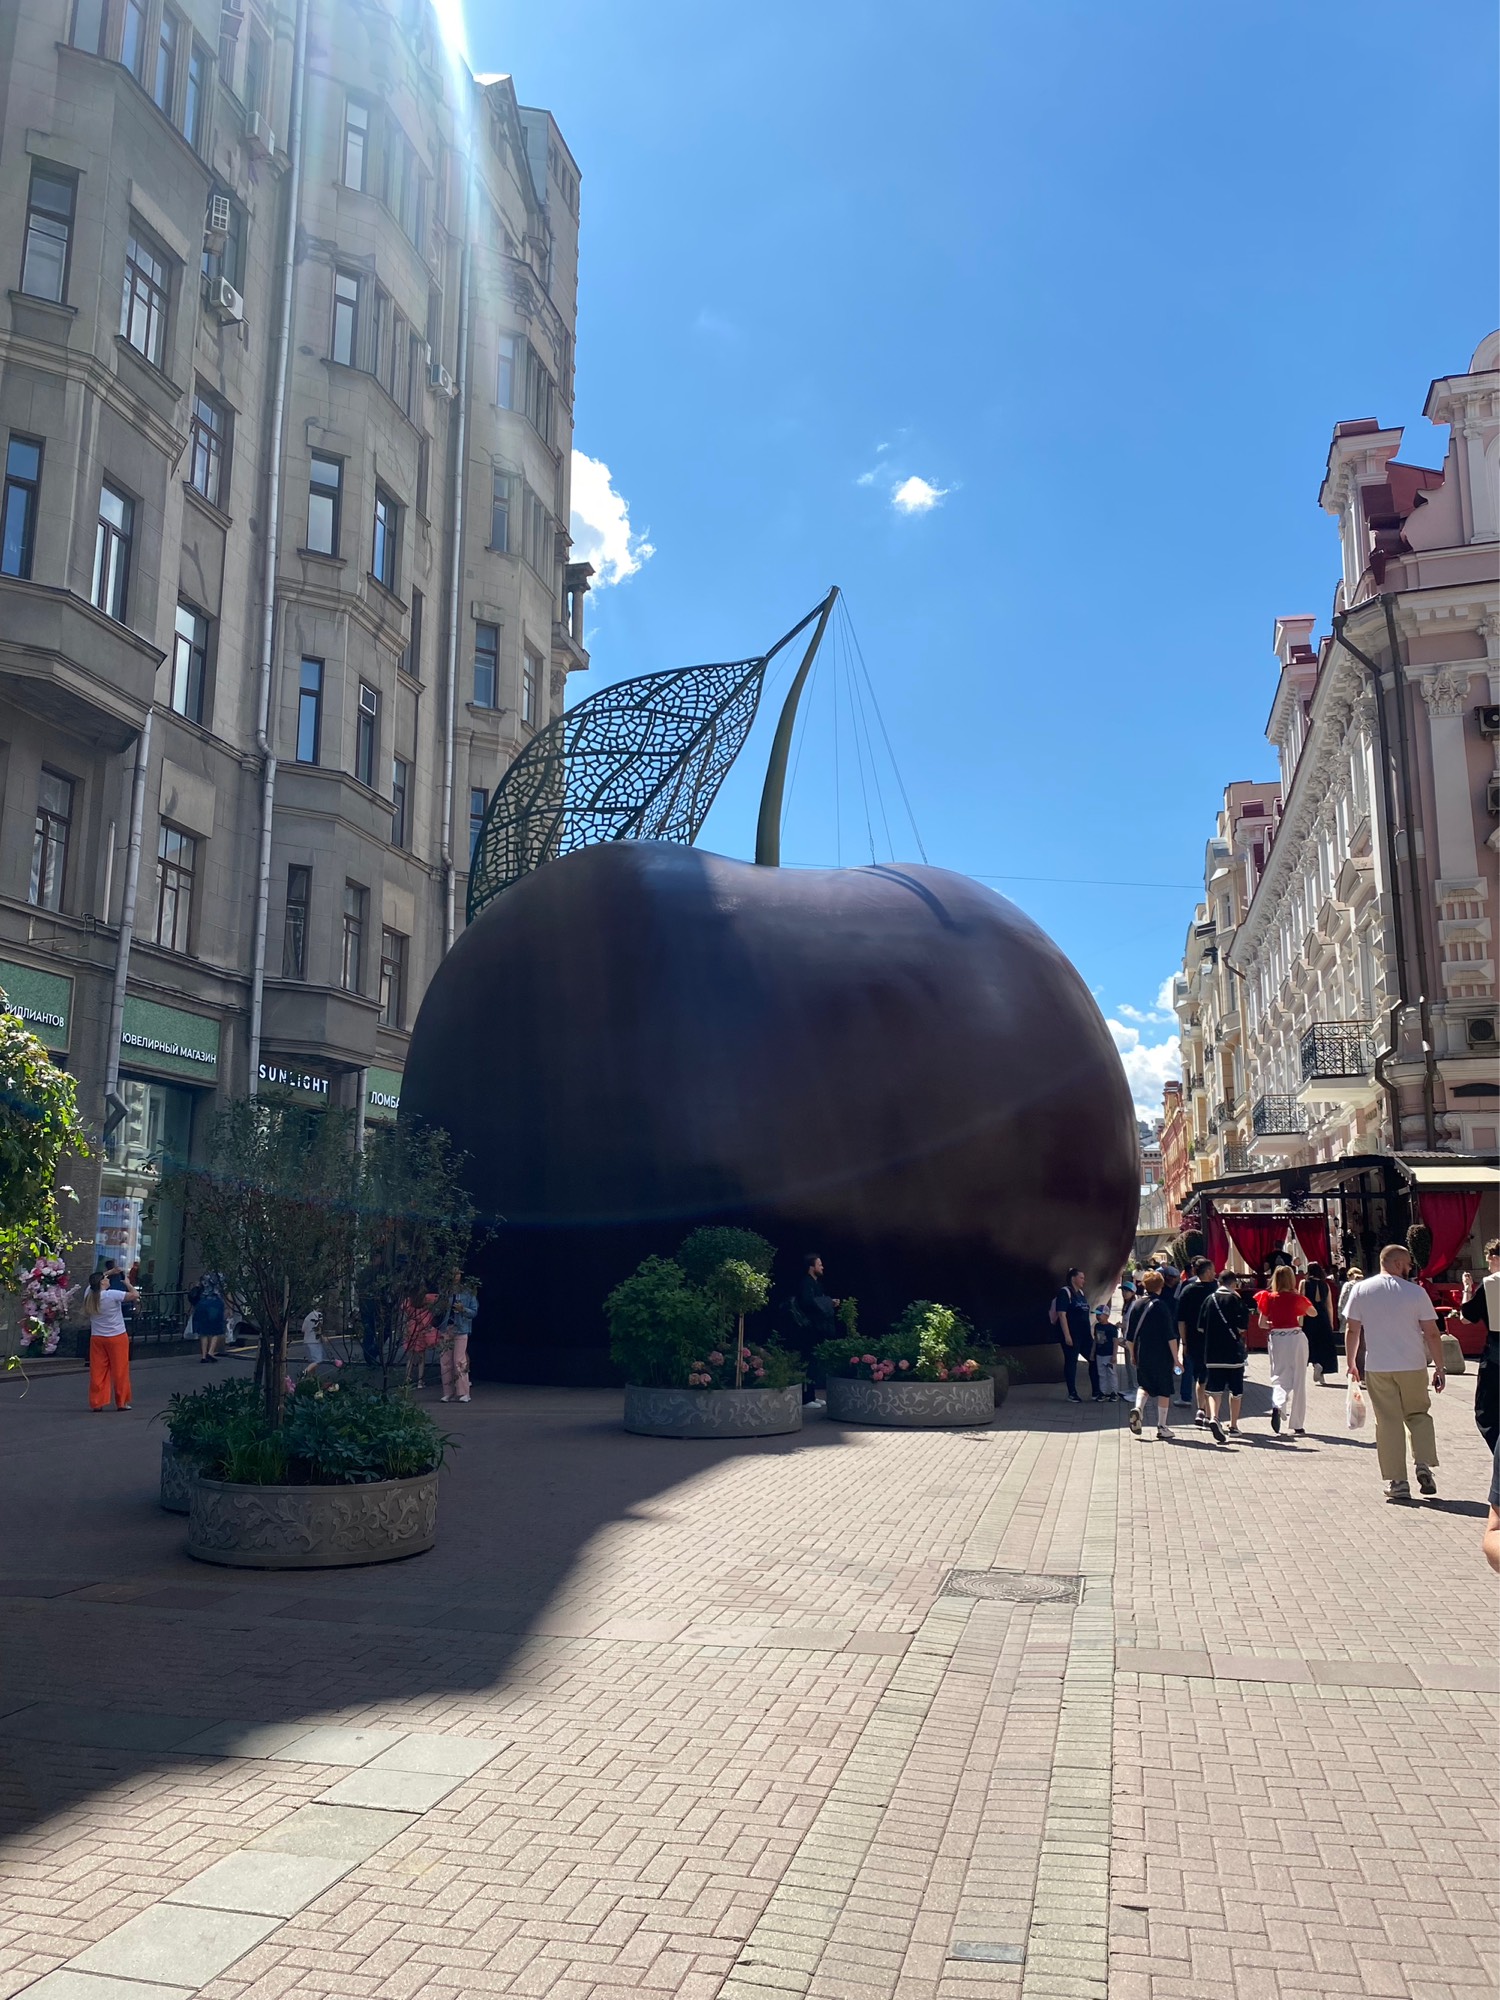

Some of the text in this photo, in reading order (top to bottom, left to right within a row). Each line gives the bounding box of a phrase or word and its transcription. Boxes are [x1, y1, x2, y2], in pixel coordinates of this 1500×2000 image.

[122, 1032, 217, 1064] ЮВЕЛИРНЫЙ МАГАЗИН
[259, 1064, 329, 1093] SUNLIGHT
